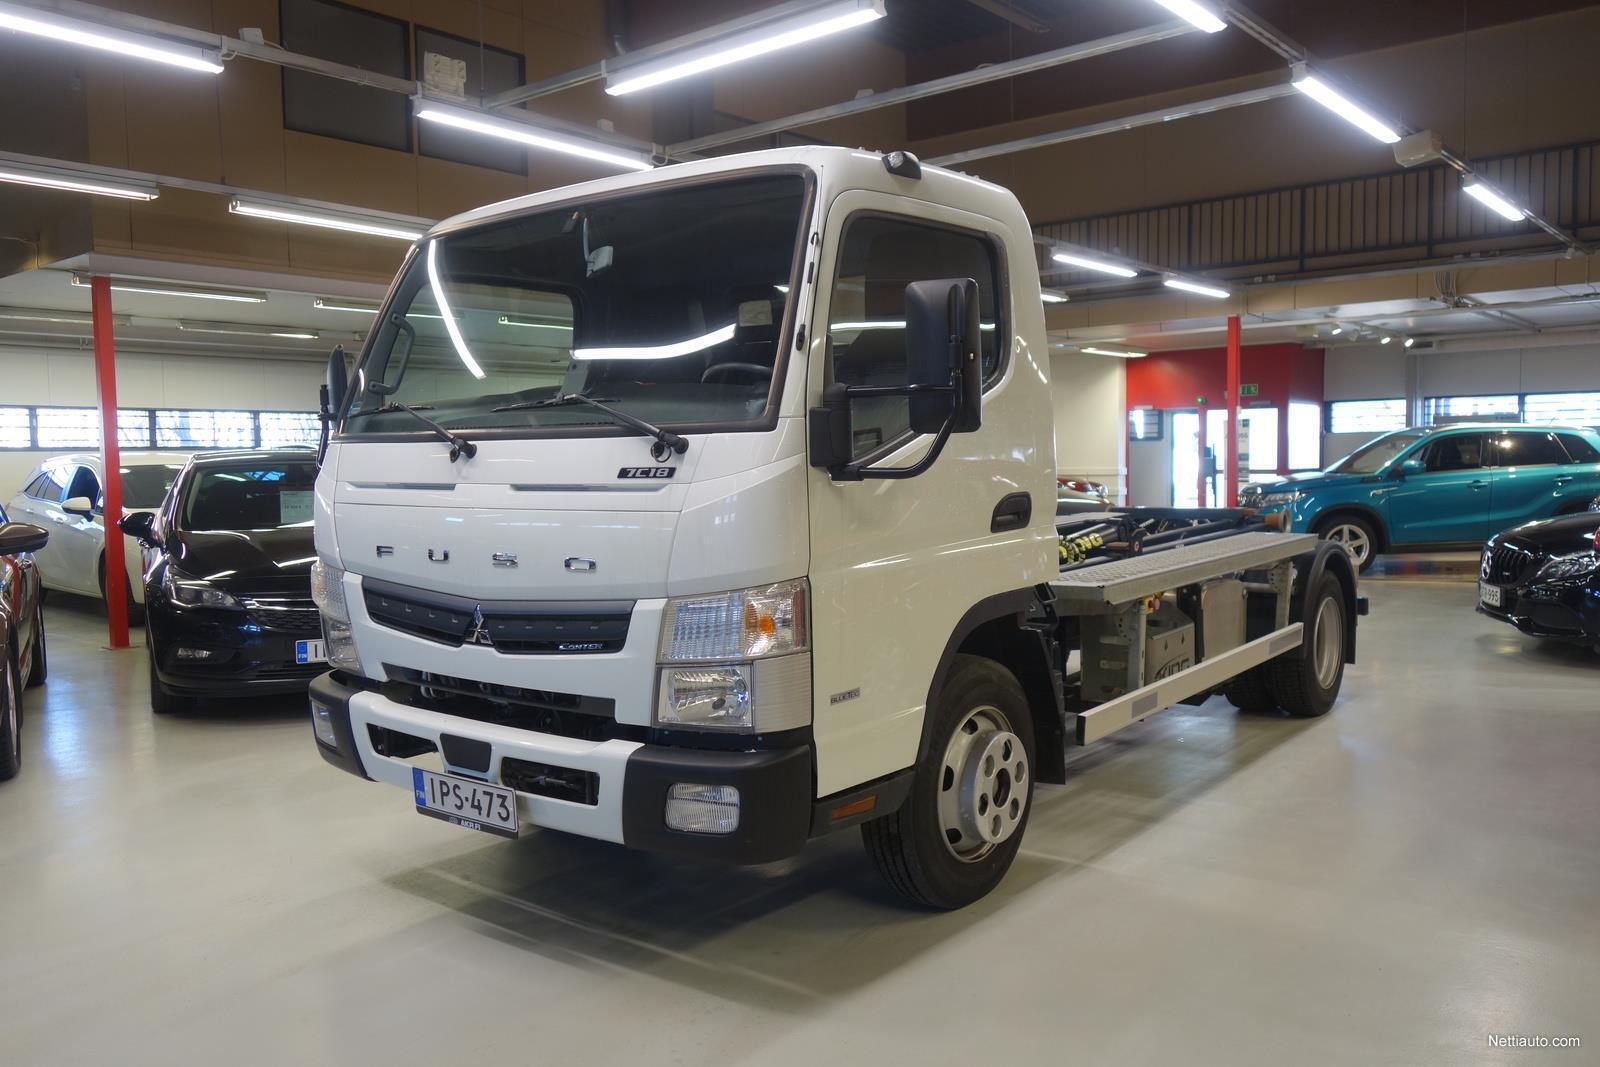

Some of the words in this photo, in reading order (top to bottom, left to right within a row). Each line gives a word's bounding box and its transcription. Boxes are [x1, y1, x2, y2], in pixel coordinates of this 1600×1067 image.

[625, 468, 669, 477] 7C18
[376, 545, 597, 572] FUSO
[430, 777, 510, 822] IPS-473
